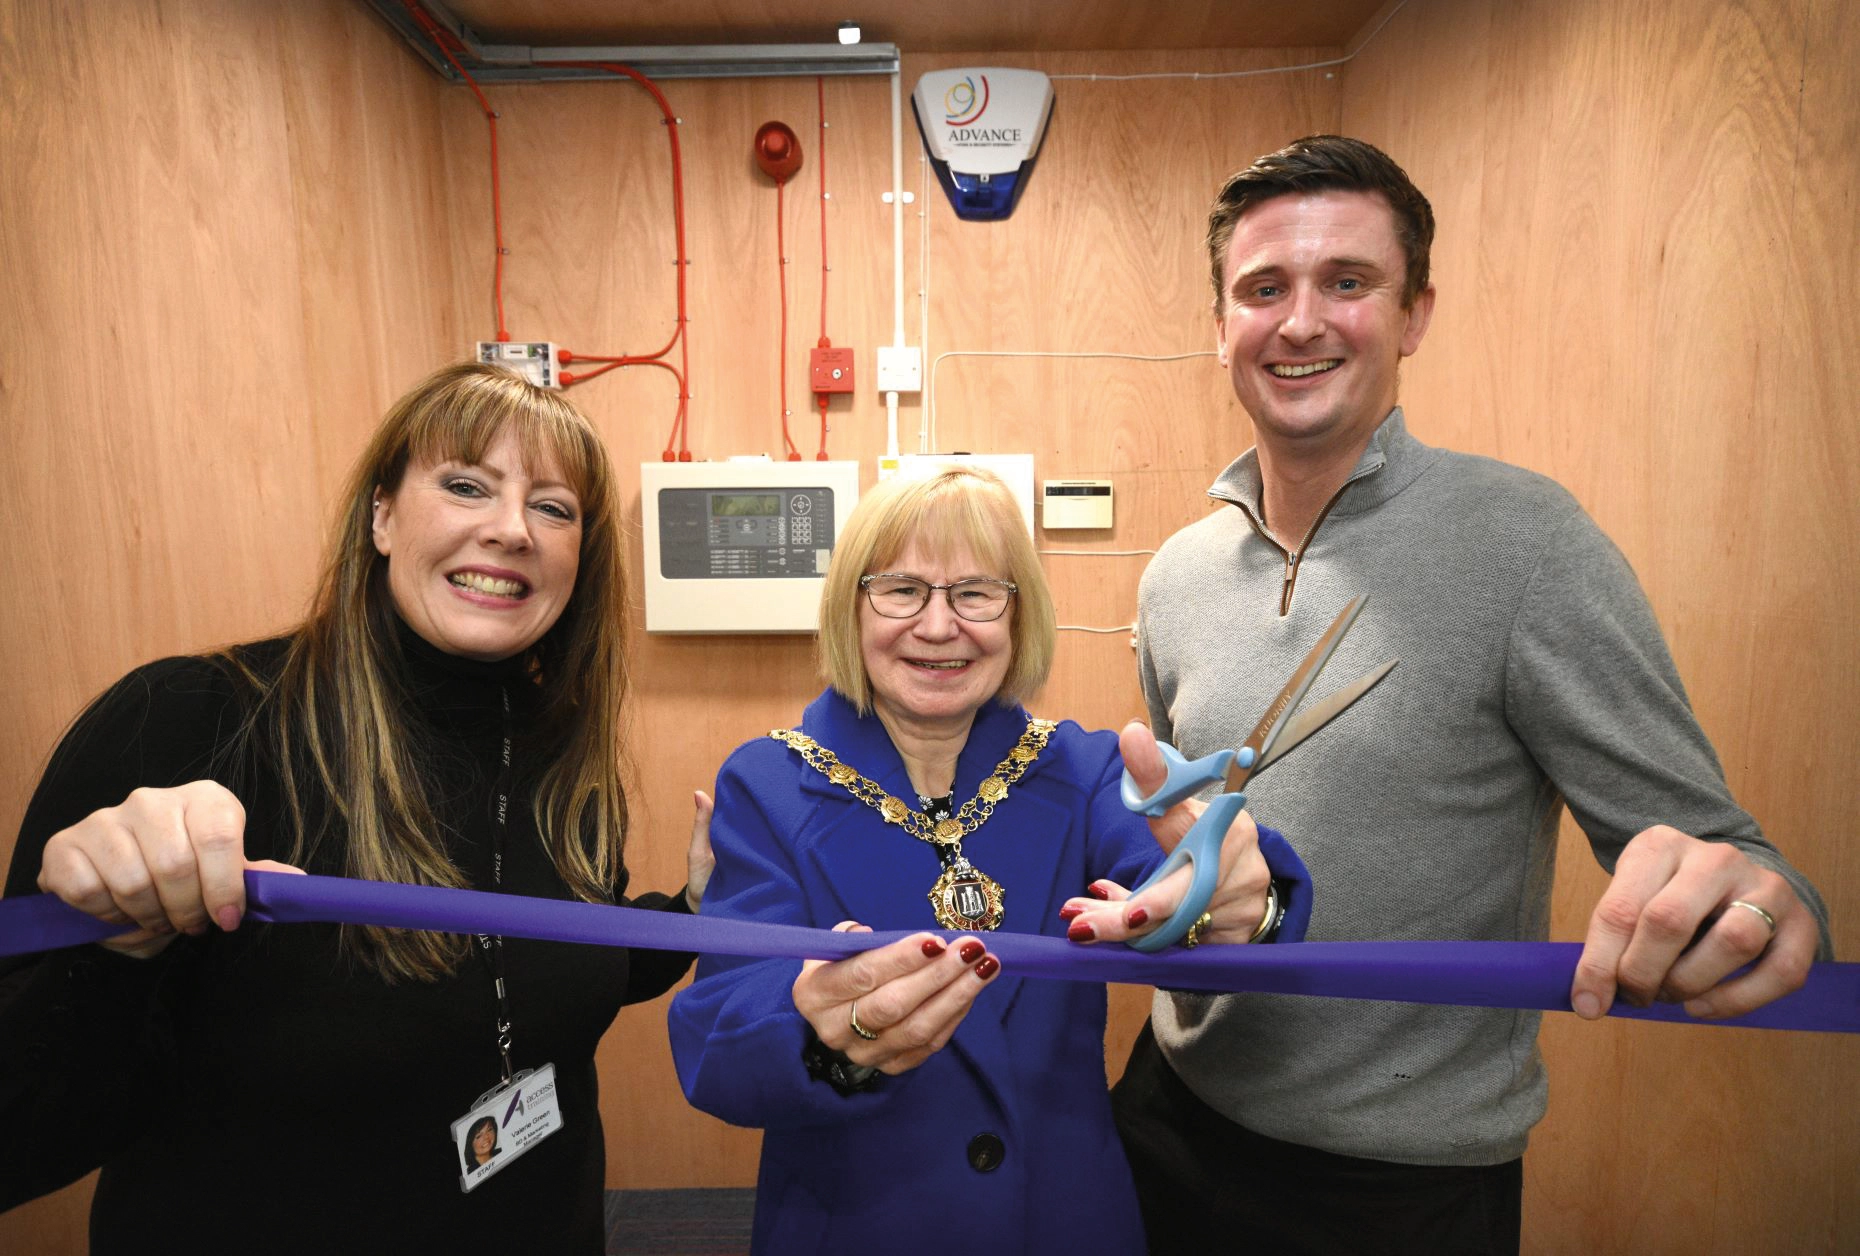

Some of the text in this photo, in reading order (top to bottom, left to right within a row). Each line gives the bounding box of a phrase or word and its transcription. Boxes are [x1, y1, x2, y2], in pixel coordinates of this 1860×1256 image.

[949, 128, 1022, 142] ADVANCE
[502, 738, 511, 767] STAFF
[497, 794, 507, 825] STAFF
[494, 853, 502, 885] STAFF
[526, 1082, 554, 1104] access
[511, 1110, 551, 1138] Valerie Green
[477, 1160, 496, 1178] STAFF
